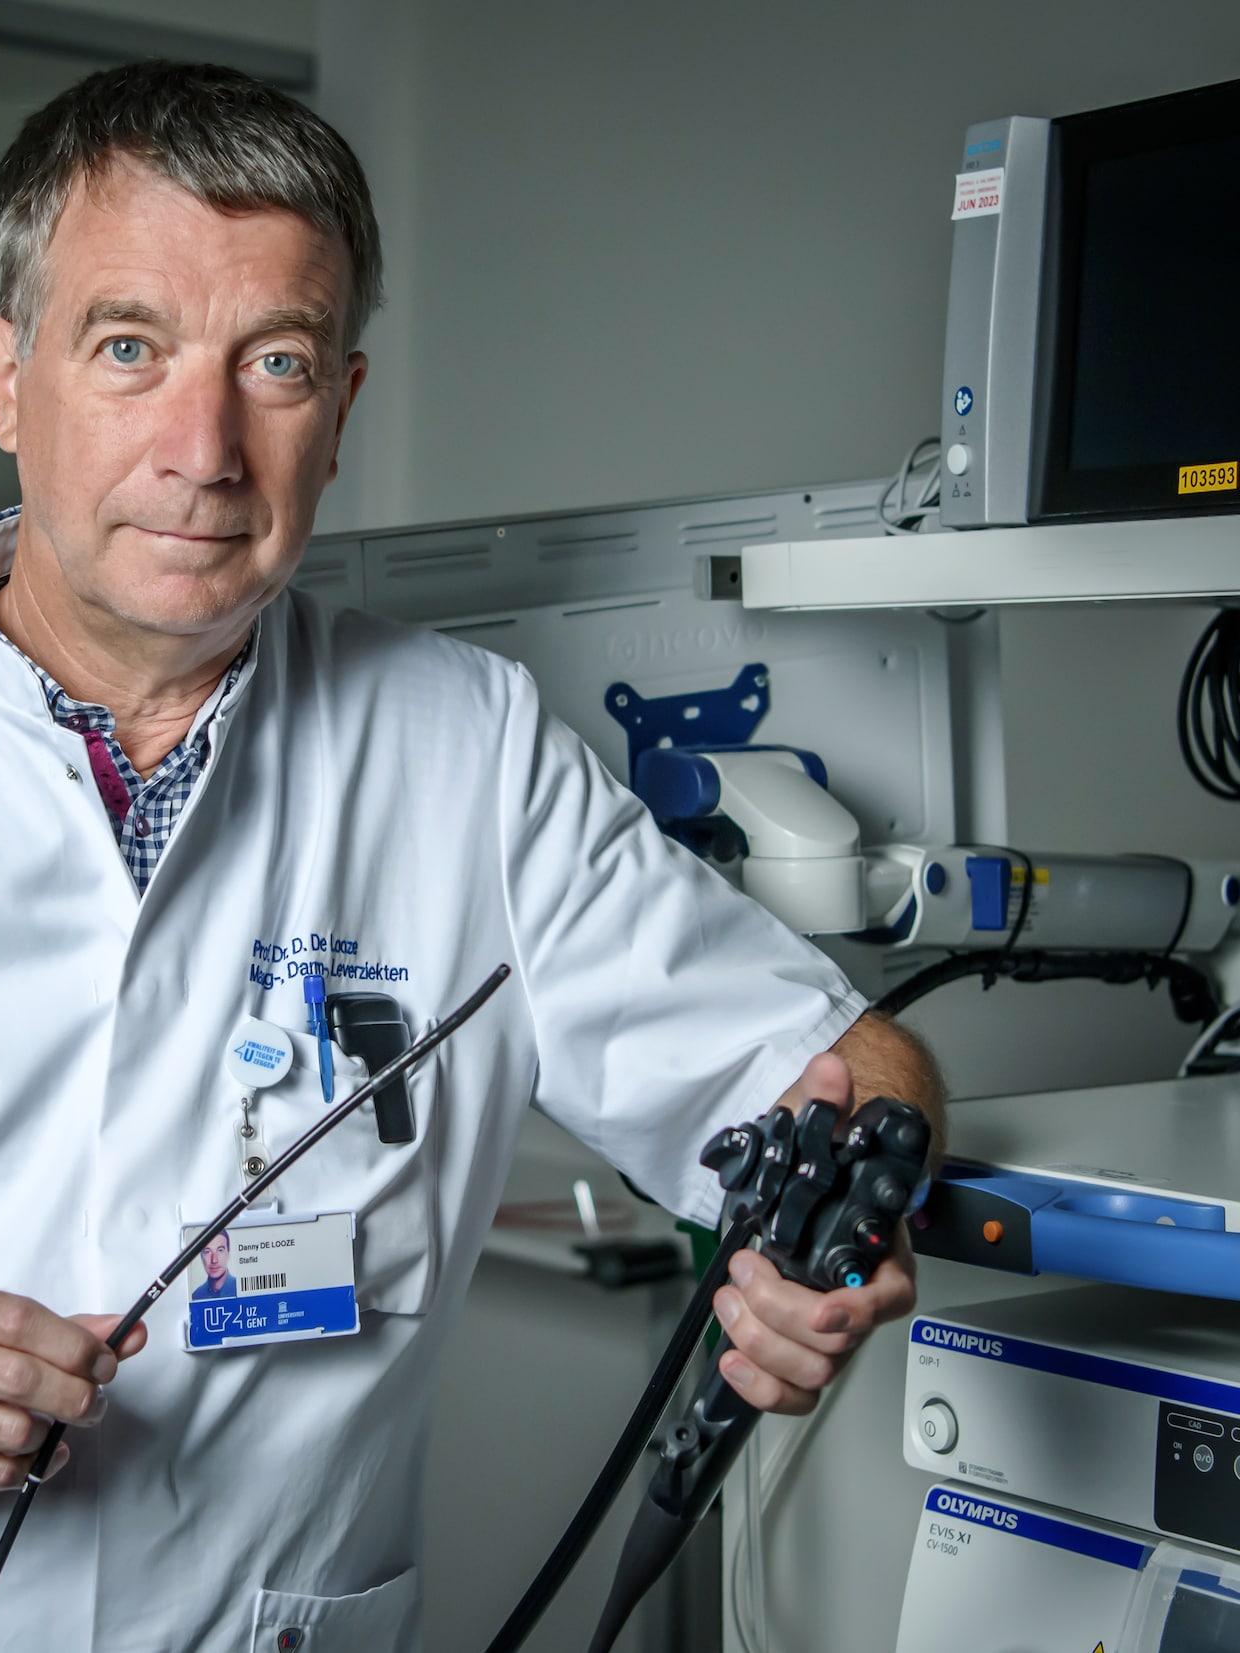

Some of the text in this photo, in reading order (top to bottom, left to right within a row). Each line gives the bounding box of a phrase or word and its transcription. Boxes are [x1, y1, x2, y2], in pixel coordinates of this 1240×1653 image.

[958, 194, 999, 212] JUN 2023
[1181, 467, 1235, 489] 103593
[271, 945, 289, 962] Dr.
[292, 937, 307, 955] D.
[310, 933, 327, 952] De
[330, 933, 358, 955] Looze
[331, 959, 409, 981] Leverziekten
[255, 1050, 273, 1061] TEGEN
[238, 1239, 295, 1252] Danny DE LOOZE
[246, 1306, 257, 1317] UZ
[246, 1317, 267, 1328] GENT
[921, 1325, 1003, 1357] OLYMPUS
[919, 1354, 940, 1368] OIP-1
[1188, 1420, 1202, 1430] CAD
[1173, 1441, 1183, 1450] ON
[937, 1494, 1019, 1530] OLYMPUS
[929, 1523, 955, 1540] EVIS
[926, 1538, 959, 1556] CV-1500
